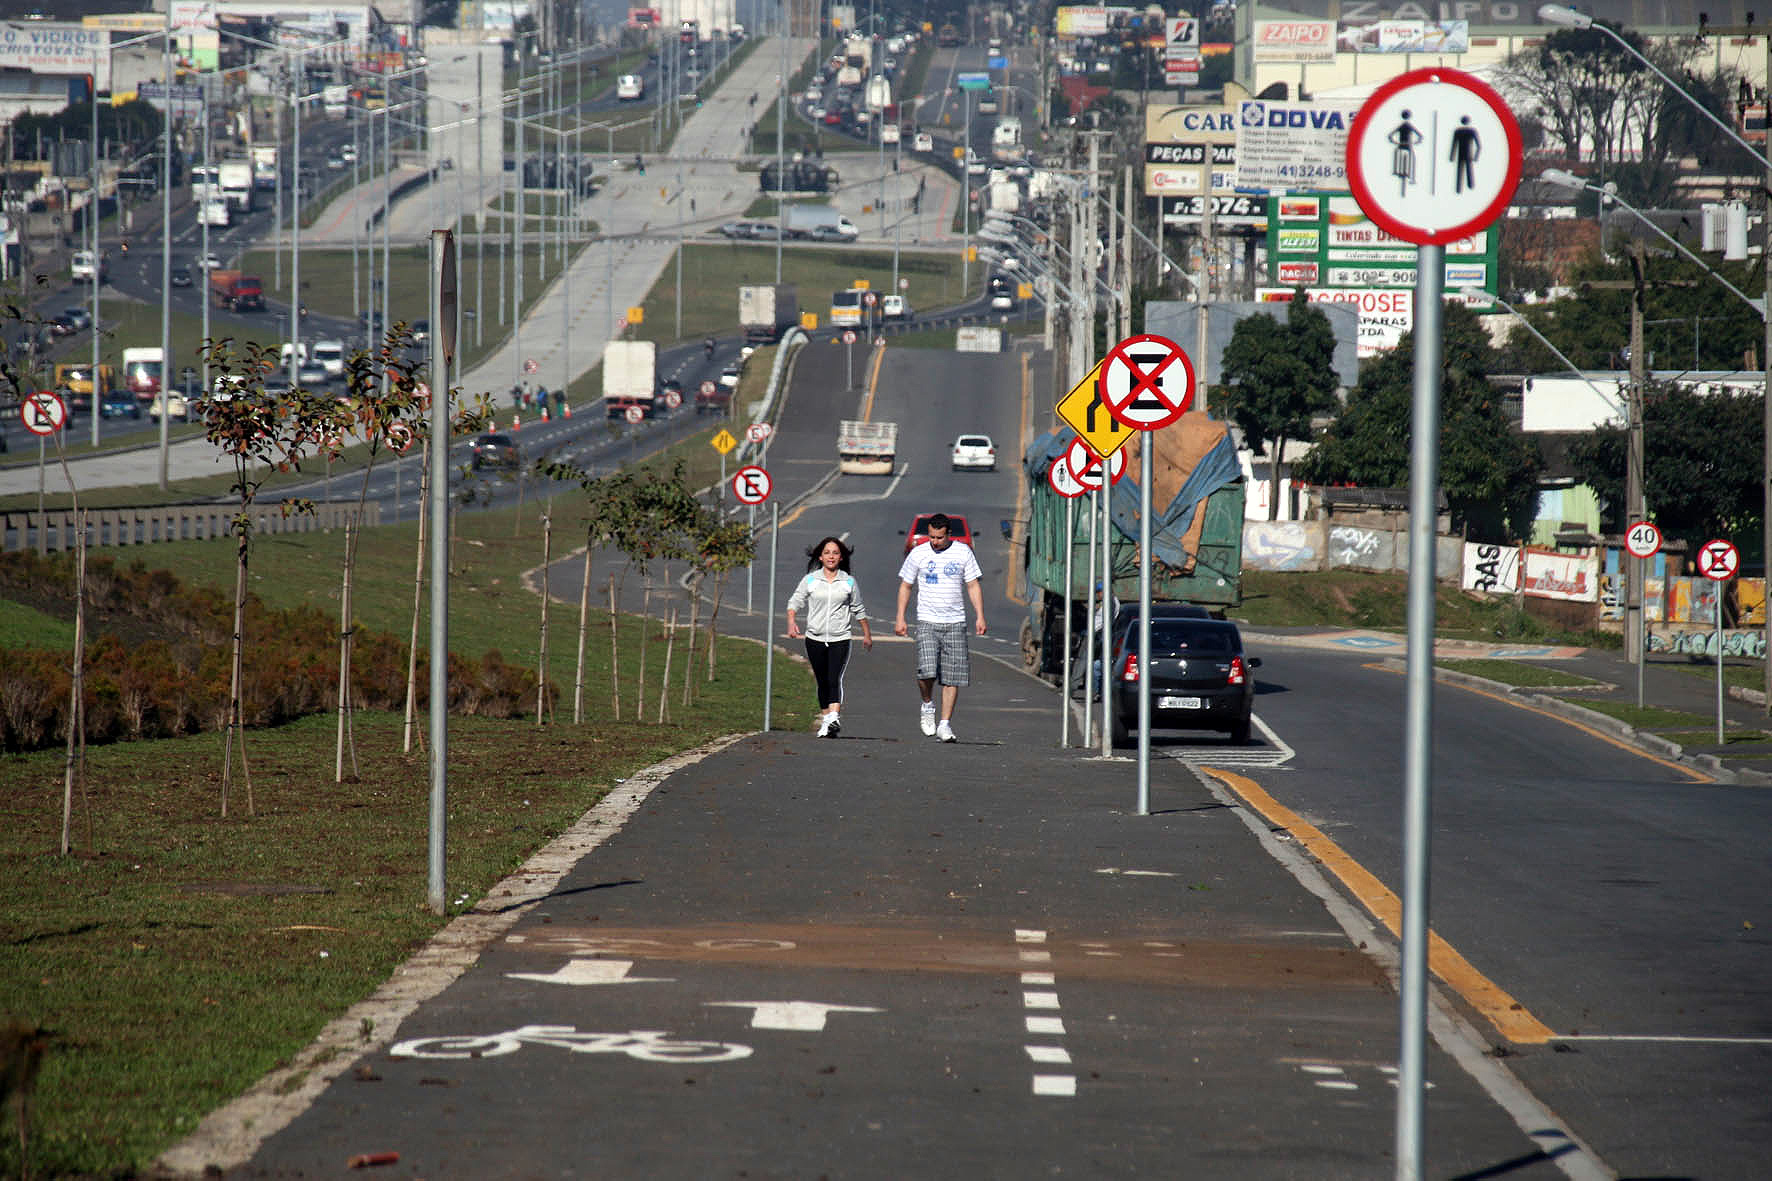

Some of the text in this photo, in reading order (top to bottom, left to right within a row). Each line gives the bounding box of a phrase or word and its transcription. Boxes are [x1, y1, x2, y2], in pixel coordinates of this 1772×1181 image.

[1342, 1, 1519, 20] ZAIPO
[1267, 24, 1323, 41] ZAIPO
[1269, 110, 1345, 130] DOVA
[1152, 147, 1203, 162] PEÇAS
[1335, 230, 1373, 241] TINTAS
[745, 474, 761, 497] E
[1631, 528, 1655, 543] 40
